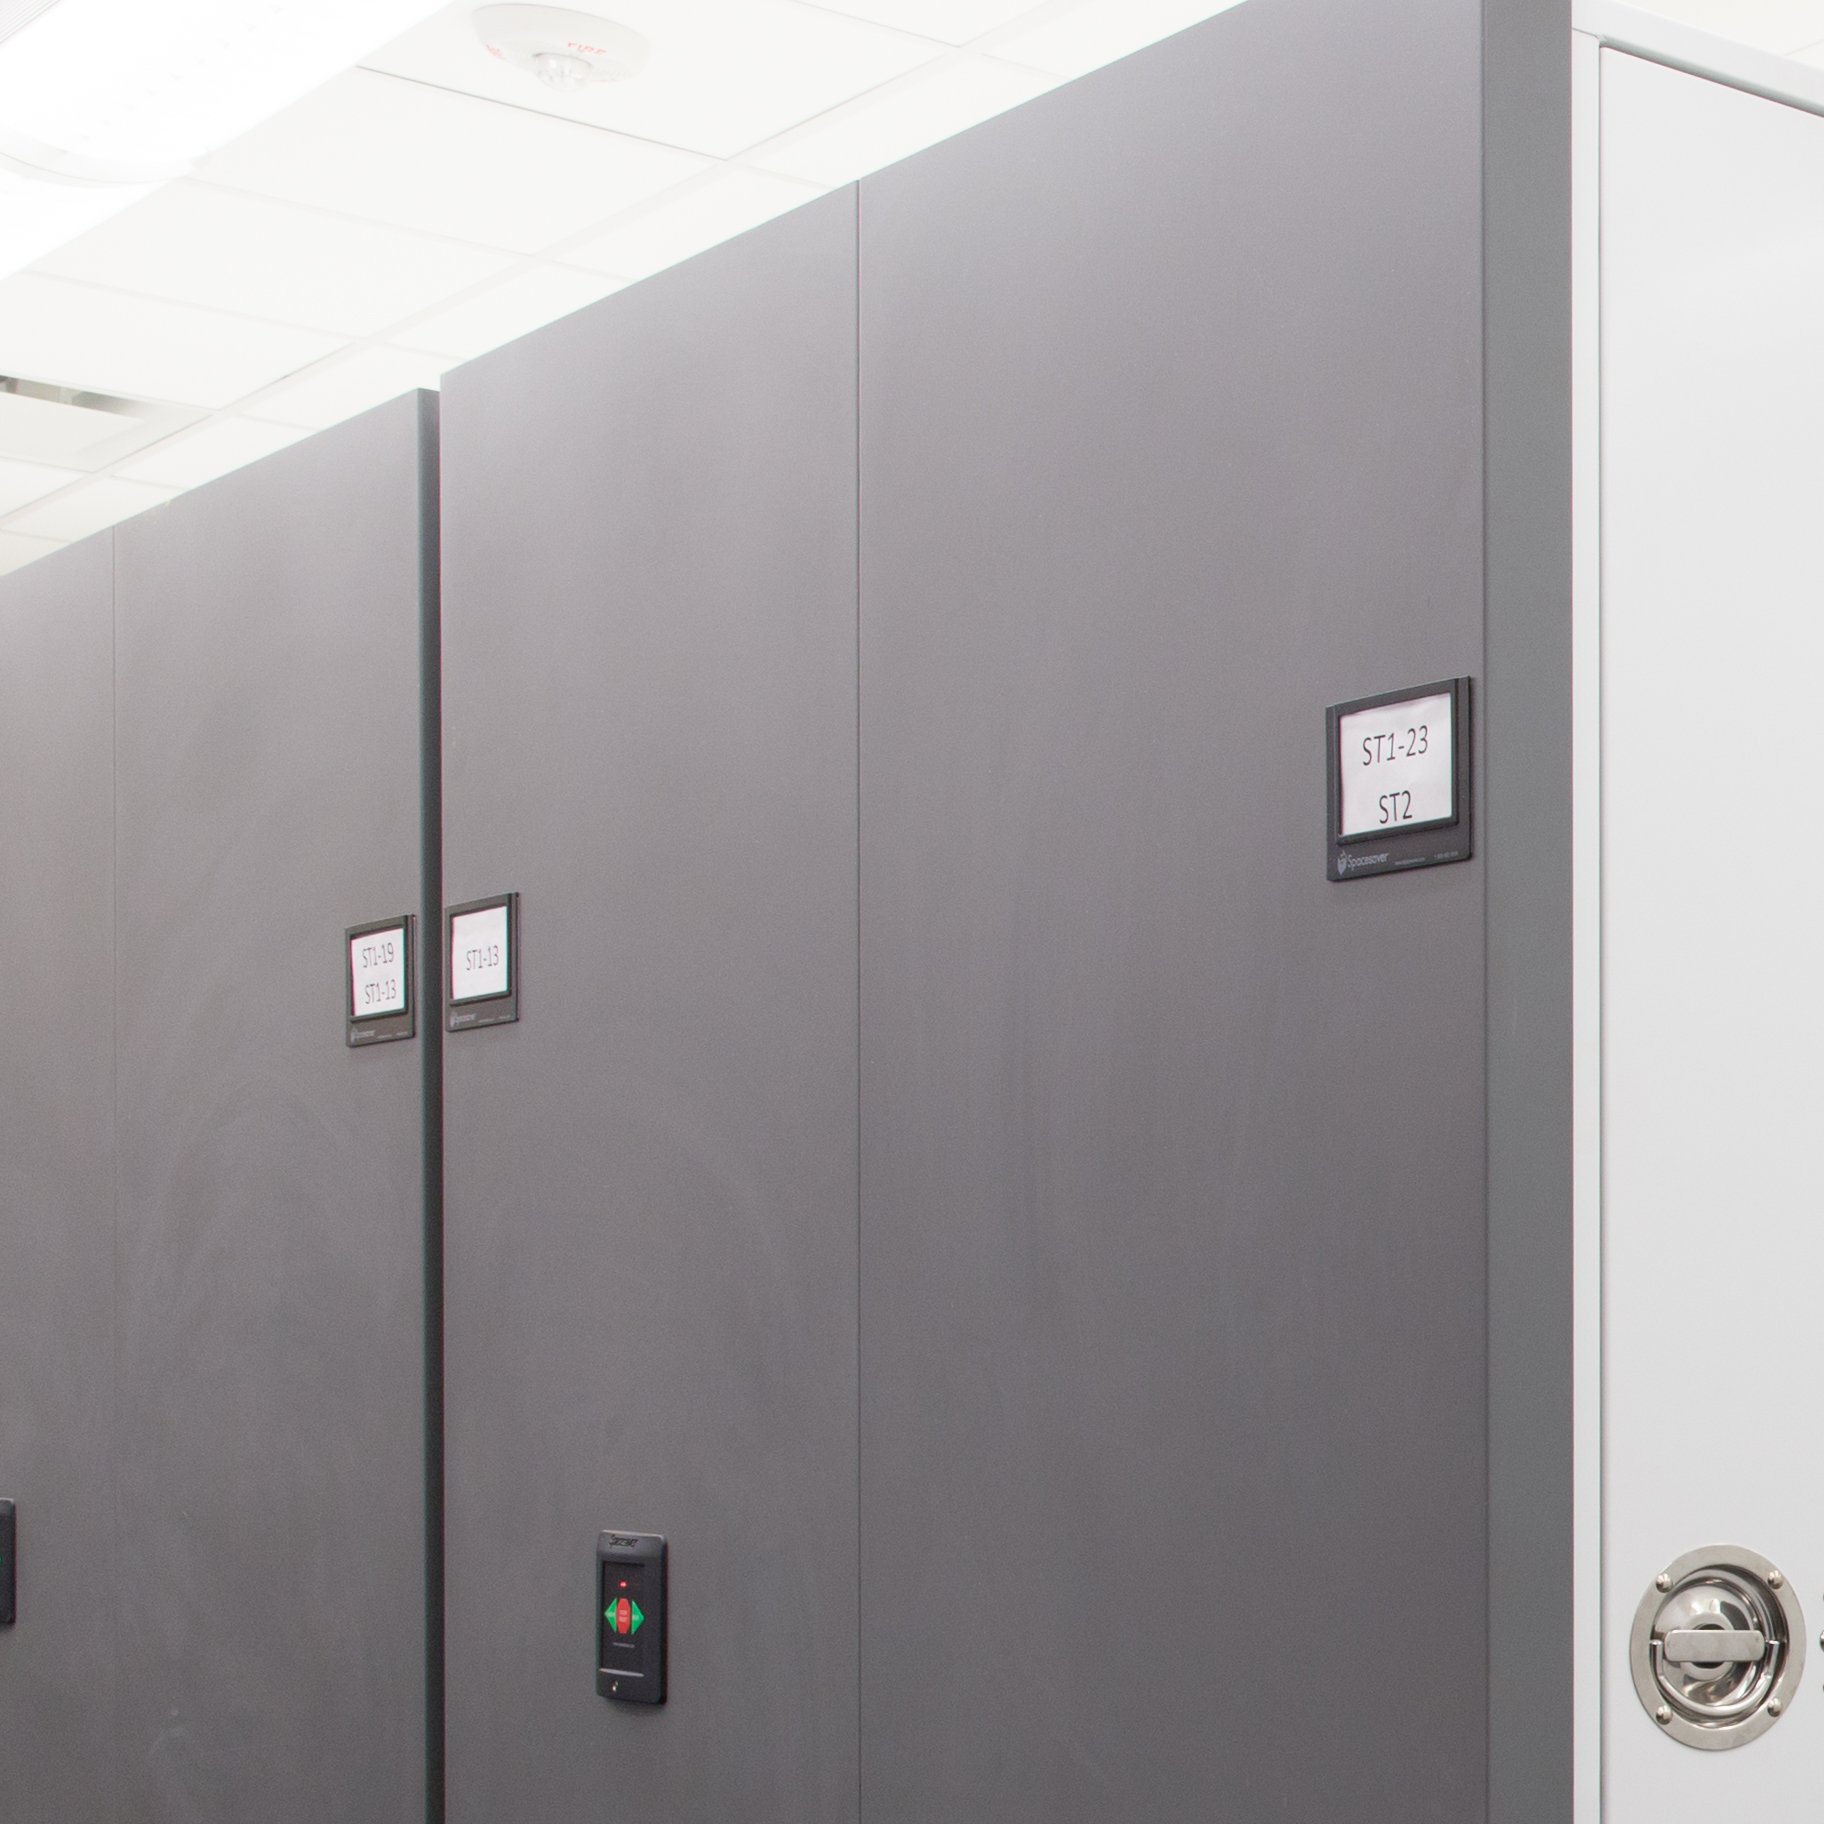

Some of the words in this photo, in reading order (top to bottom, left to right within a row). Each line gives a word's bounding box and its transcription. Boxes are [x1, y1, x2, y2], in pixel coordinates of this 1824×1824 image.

[1362, 725, 1429, 766] ST1-23
[1379, 790, 1413, 824] ST2
[466, 945, 499, 971] ST1-13
[365, 979, 397, 1005] ST1-13
